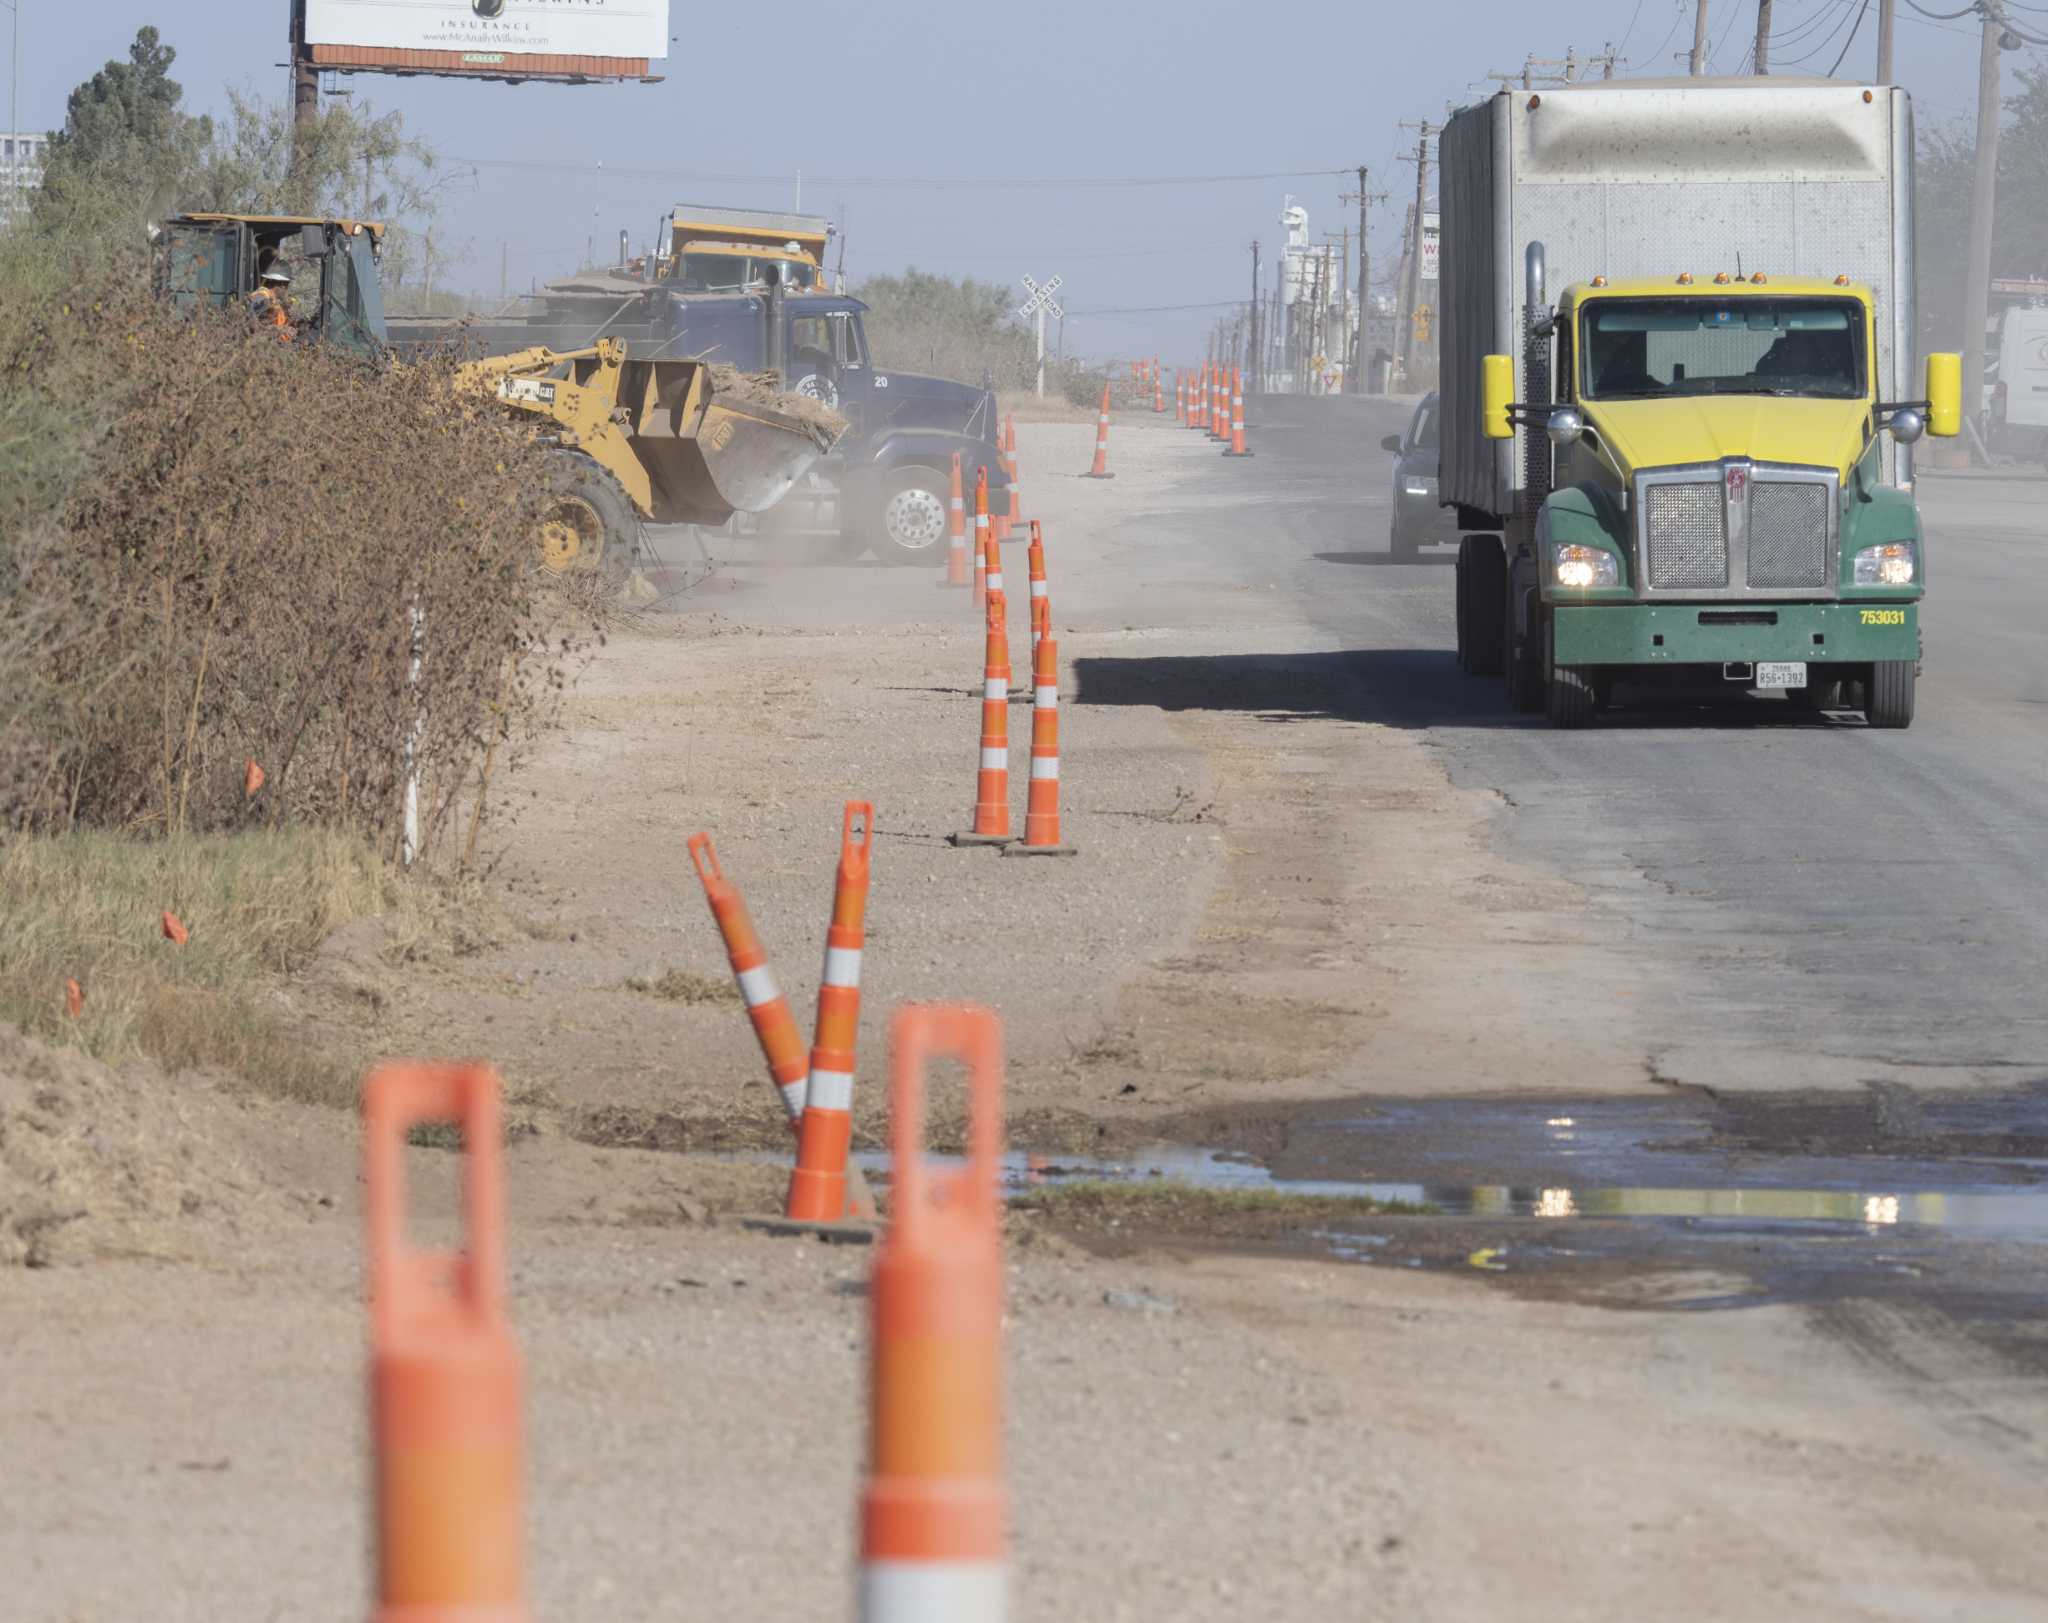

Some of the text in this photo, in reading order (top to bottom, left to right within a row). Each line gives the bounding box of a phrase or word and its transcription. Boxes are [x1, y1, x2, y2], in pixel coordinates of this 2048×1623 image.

[440, 20, 530, 31] INSURANCE
[874, 375, 888, 388] 20
[1859, 610, 1905, 625] 753031
